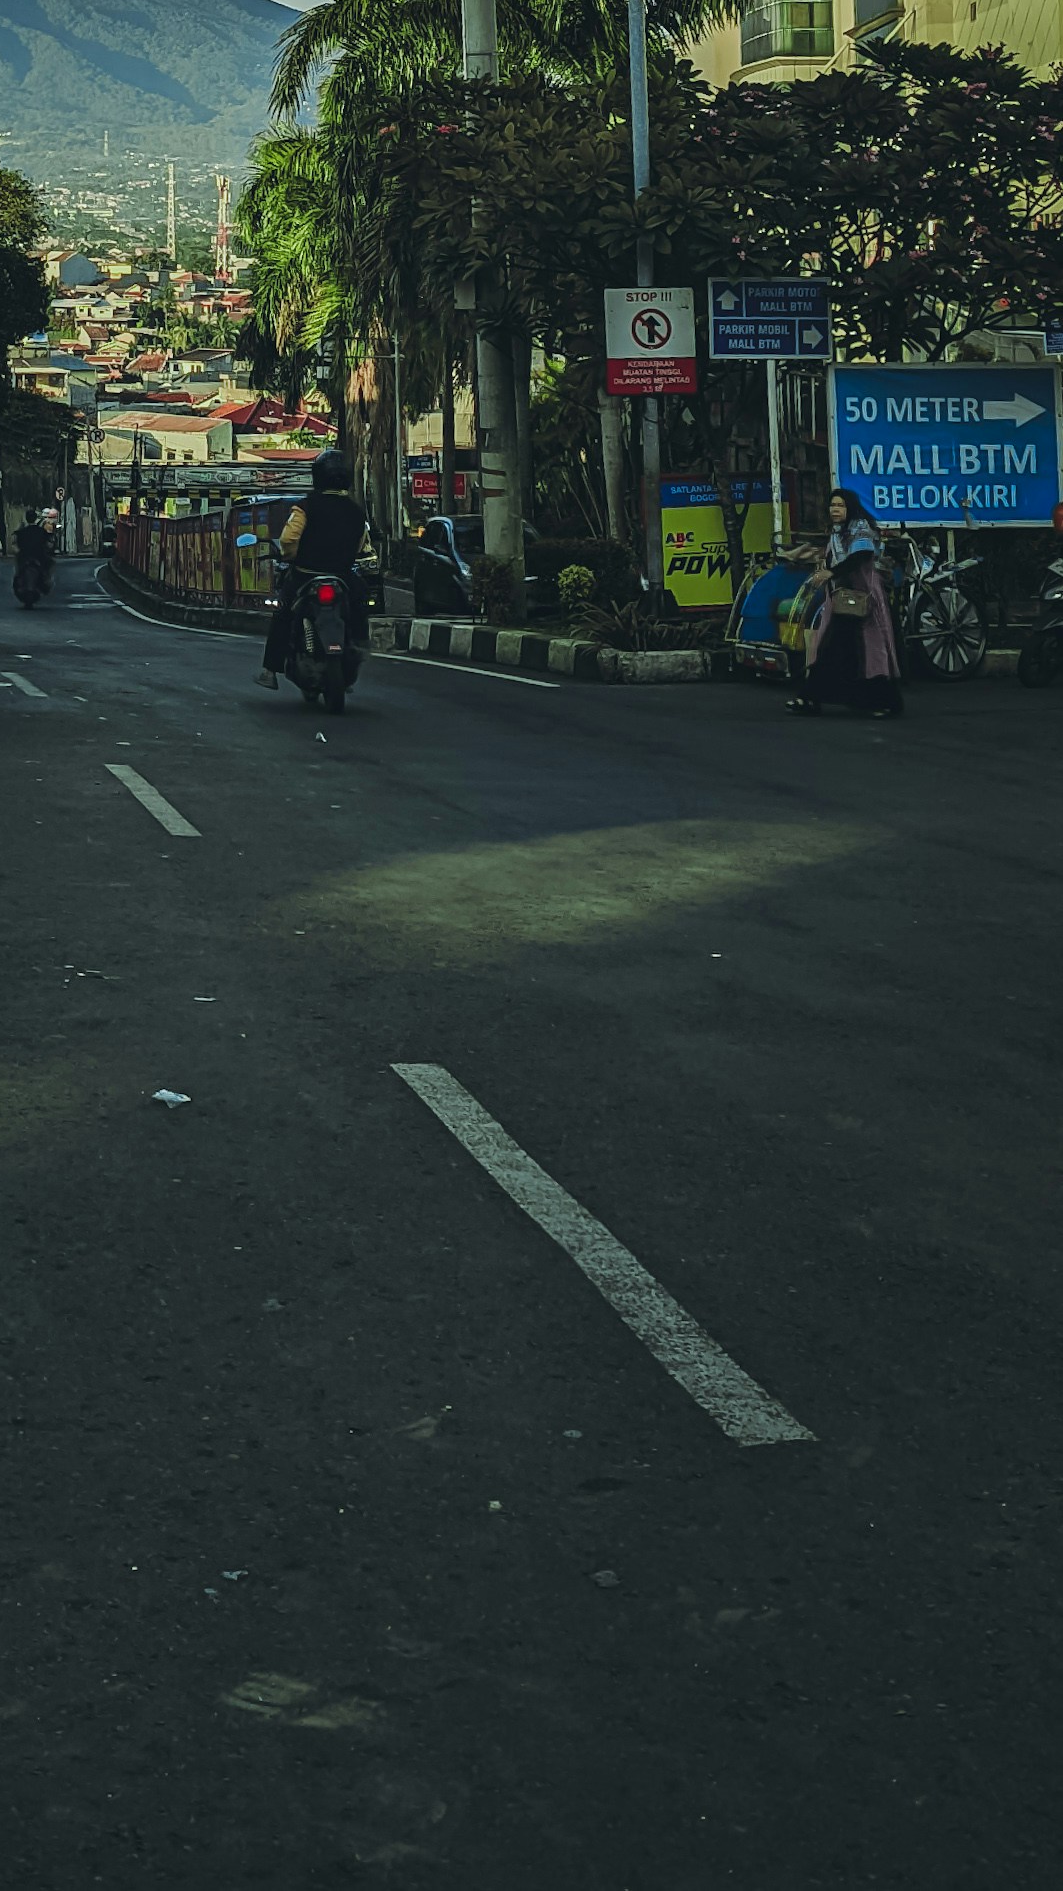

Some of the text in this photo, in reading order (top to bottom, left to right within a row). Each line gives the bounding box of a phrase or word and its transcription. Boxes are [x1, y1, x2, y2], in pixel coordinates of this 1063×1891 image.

[626, 291, 657, 302] STOP
[748, 287, 820, 298] PARKIR MOTO
[759, 301, 813, 312] MALL BTM
[718, 324, 790, 335] PARKIR MOBIL
[728, 339, 781, 350] MALL BTM
[844, 396, 981, 423] 50 METER
[850, 443, 1037, 475] MALL BTM
[670, 483, 719, 495] SATLANTA
[873, 484, 1017, 510] BELOK KIRI
[666, 531, 695, 543] ABC
